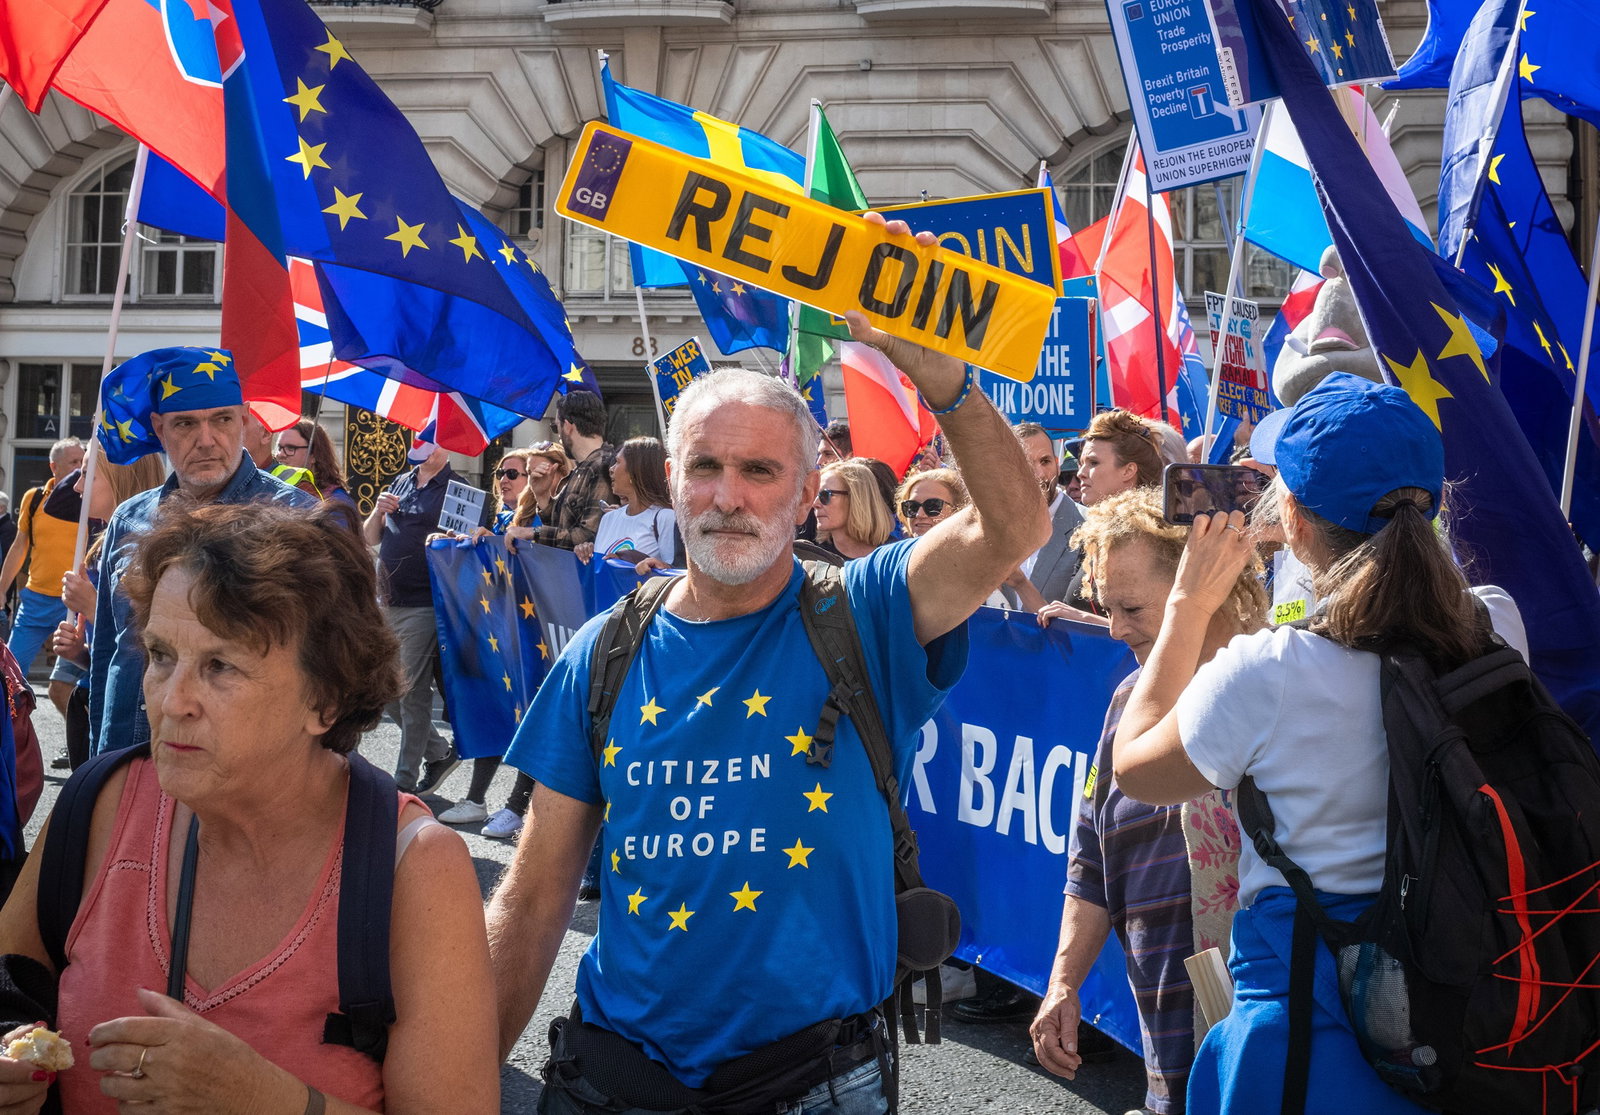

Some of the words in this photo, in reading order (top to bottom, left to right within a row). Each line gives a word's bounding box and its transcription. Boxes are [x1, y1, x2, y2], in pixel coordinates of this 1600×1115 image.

[1153, 6, 1191, 26] UNION
[1157, 25, 1186, 41] Trade
[1161, 32, 1211, 54] Prosperity
[1144, 74, 1174, 91] Brexit
[1177, 65, 1210, 83] Britain
[1148, 87, 1185, 105] Poverty
[1151, 102, 1188, 119] Decline
[1153, 154, 1186, 170] REJOIN
[1187, 149, 1206, 162] THE
[1156, 168, 1187, 183] UNION
[1189, 153, 1251, 176] SUPERHIGHW
[575, 187, 608, 210] GB
[671, 366, 693, 391] IN
[993, 382, 1017, 414] UK
[1021, 383, 1075, 416] DONE
[456, 503, 466, 516] BE
[1276, 600, 1302, 618] 3.5%
[626, 753, 771, 786] CITIZEN
[669, 795, 715, 821] OF
[624, 827, 766, 860] EUROPE
